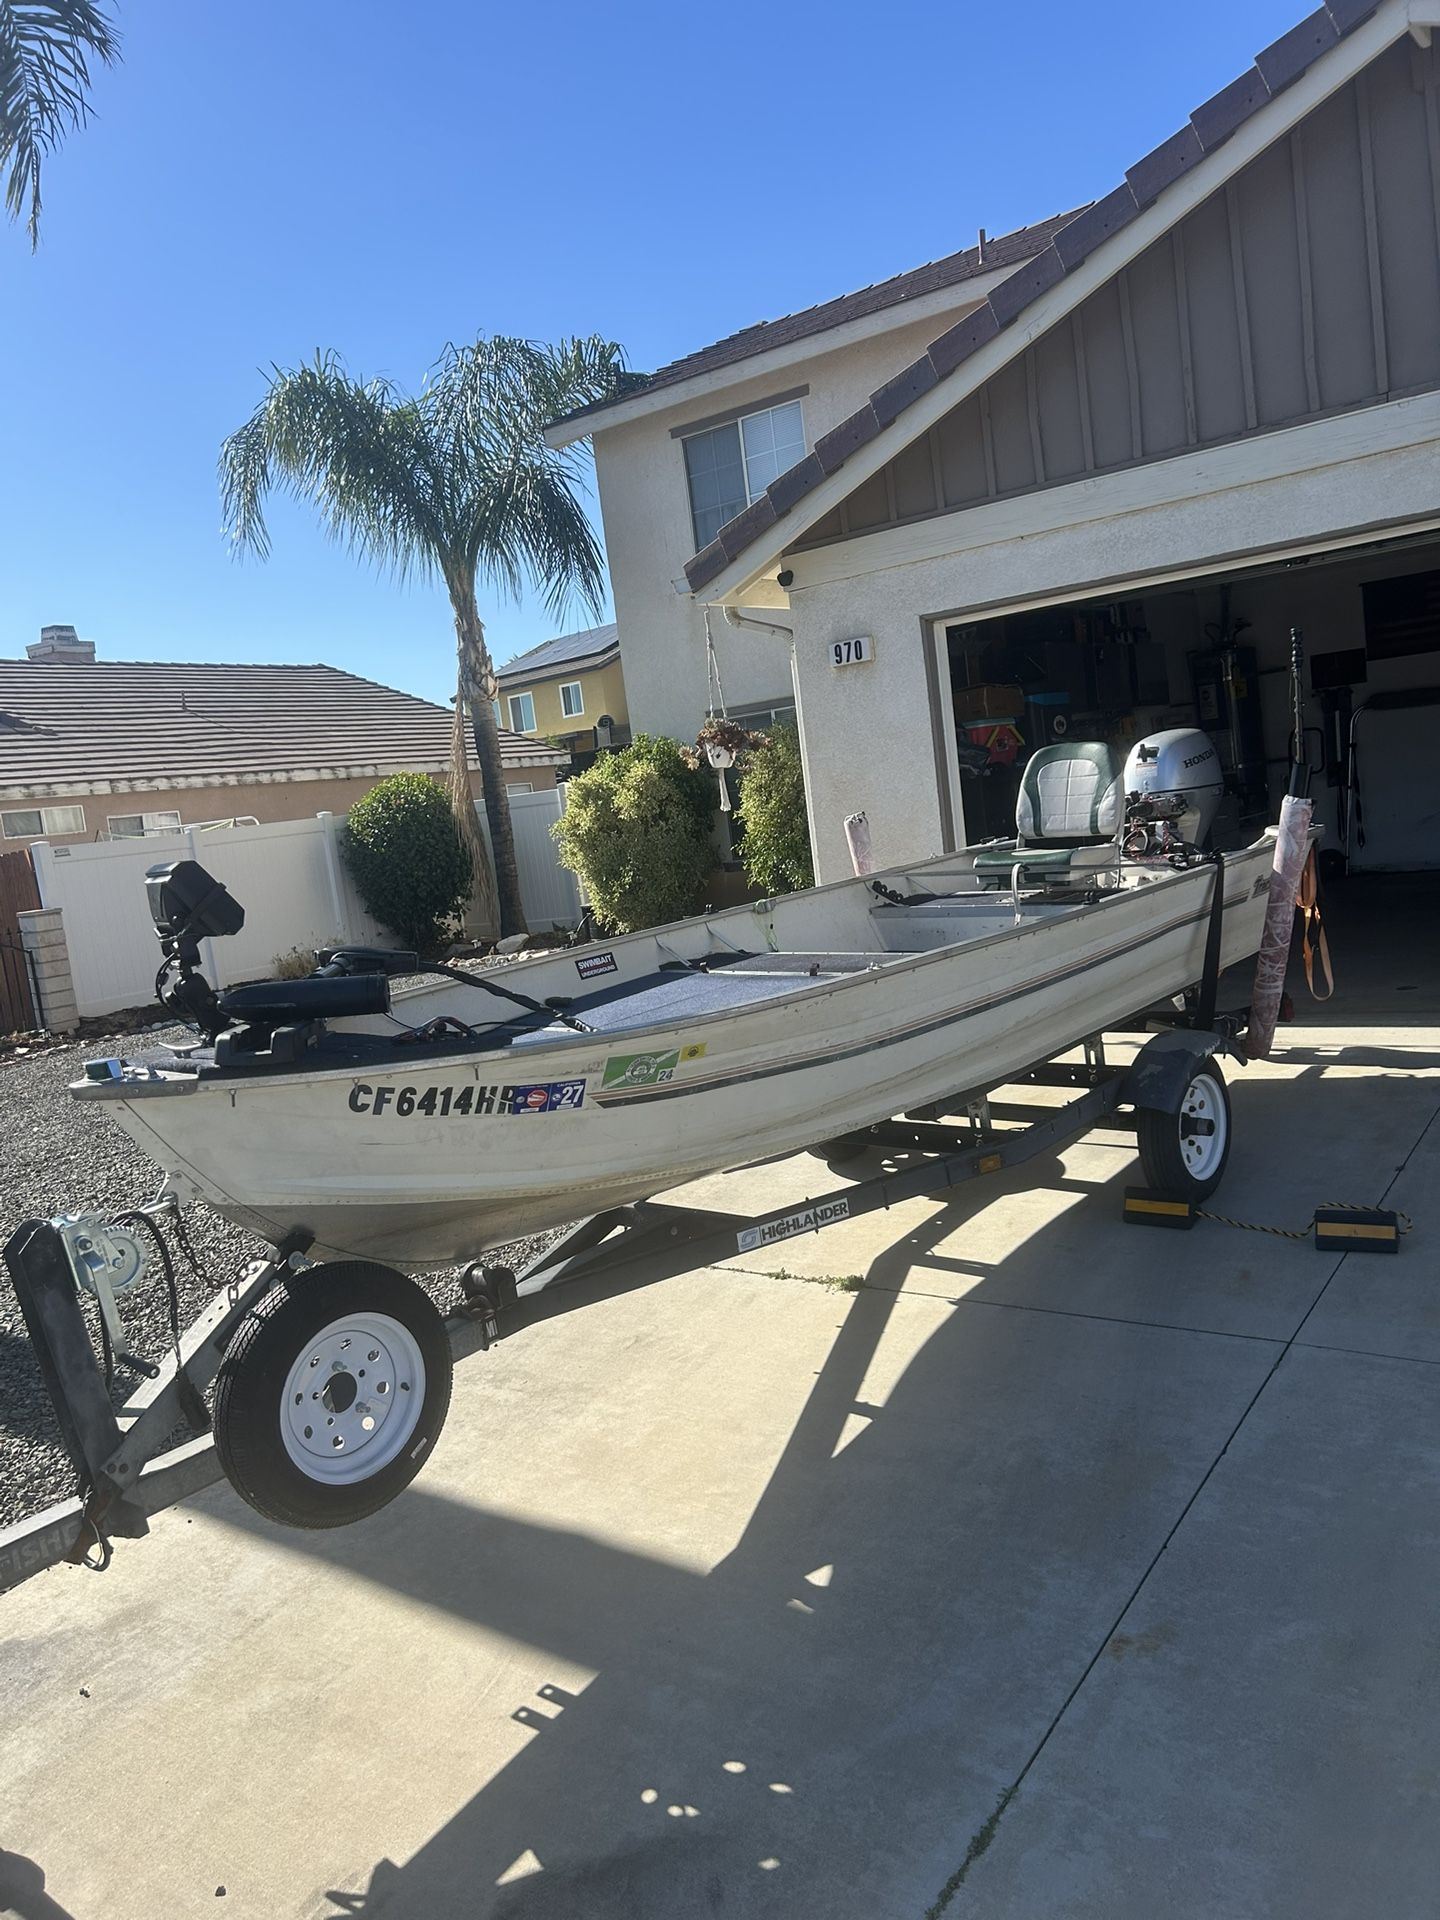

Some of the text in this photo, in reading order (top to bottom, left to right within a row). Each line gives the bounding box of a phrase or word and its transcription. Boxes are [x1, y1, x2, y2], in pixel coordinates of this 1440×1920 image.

[834, 640, 863, 665] 970
[577, 954, 613, 970] SWIMBAIT
[658, 1069, 674, 1081] 24
[560, 1085, 584, 1105] 27
[761, 1202, 848, 1241] HIGHLANDER
